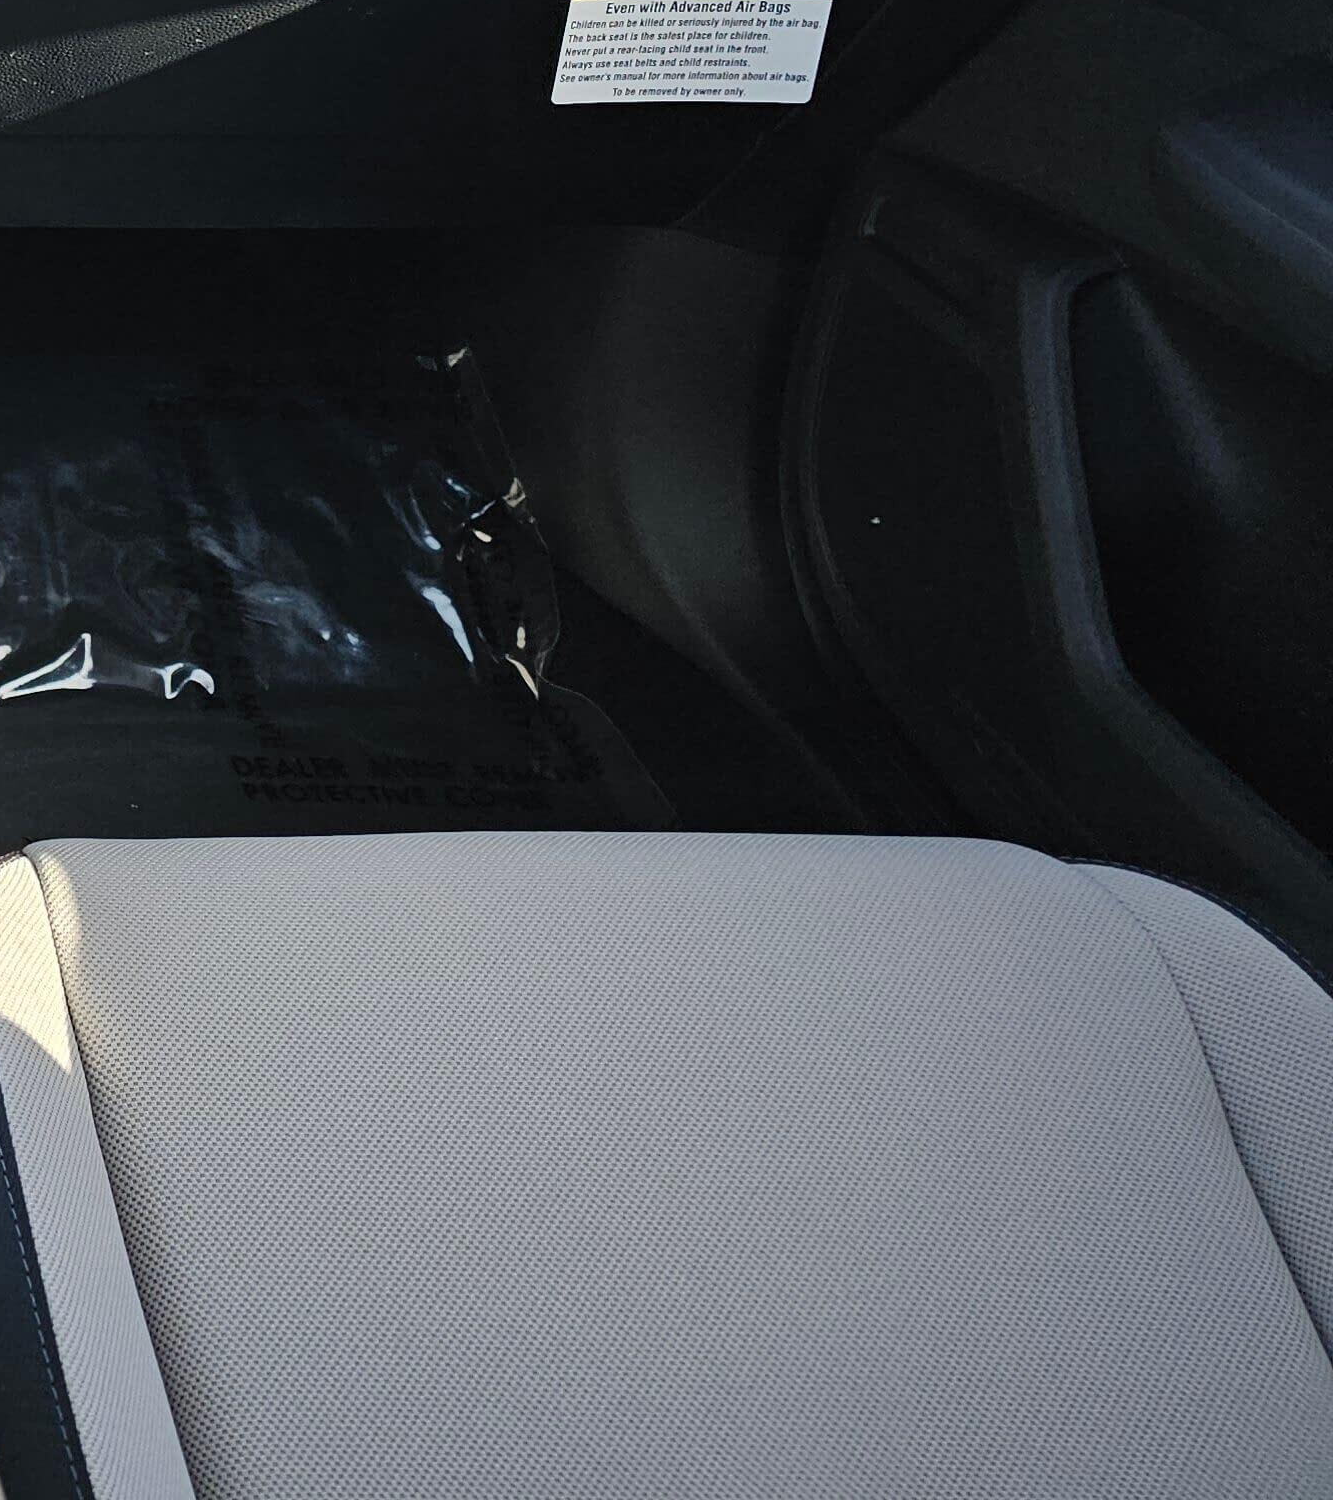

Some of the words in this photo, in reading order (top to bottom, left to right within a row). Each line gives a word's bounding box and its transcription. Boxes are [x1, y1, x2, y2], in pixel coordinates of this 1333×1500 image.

[606, 2, 635, 14] Even
[639, 1, 666, 13] with
[669, 0, 732, 13] Advanced
[735, 0, 755, 13] Air
[759, 1, 791, 15] Bags
[570, 20, 606, 30] Children
[609, 20, 623, 29] can
[627, 19, 638, 28] be
[640, 18, 664, 27] killed
[667, 18, 677, 26] or
[678, 18, 719, 29] seriously
[721, 18, 754, 29] injured
[756, 18, 767, 29] by
[769, 18, 784, 28] the
[786, 19, 799, 28] air
[801, 19, 822, 30] bag.
[568, 34, 583, 43] The
[586, 33, 606, 42] back
[609, 32, 628, 41] seat
[630, 32, 638, 41] is
[641, 32, 654, 41] the
[657, 31, 685, 40] safest
[687, 31, 712, 41] place
[715, 31, 728, 40] for
[730, 31, 771, 41] children.
[565, 47, 591, 57] Never
[593, 46, 607, 57] put
[617, 45, 666, 55] rear-facing
[668, 45, 691, 54] child
[693, 45, 713, 54] seat
[716, 45, 724, 53] in
[727, 45, 742, 54] the
[744, 45, 769, 54] front.
[562, 60, 593, 71] Always
[614, 60, 632, 68] seat
[635, 59, 657, 68] belts
[659, 58, 676, 67] and
[679, 58, 701, 67] child
[704, 58, 751, 68] restraints.
[560, 74, 576, 83] See
[578, 73, 611, 82] owner's
[614, 72, 646, 81] manual
[648, 72, 660, 81] for
[662, 72, 686, 80] more
[688, 71, 739, 81] information
[742, 71, 768, 81] about
[770, 72, 782, 81] air
[784, 72, 809, 83] bags.
[613, 87, 623, 97] To
[625, 87, 636, 96] be
[638, 87, 677, 96] removed
[680, 87, 691, 98] by
[693, 88, 721, 96] owner
[724, 87, 746, 97] only.
